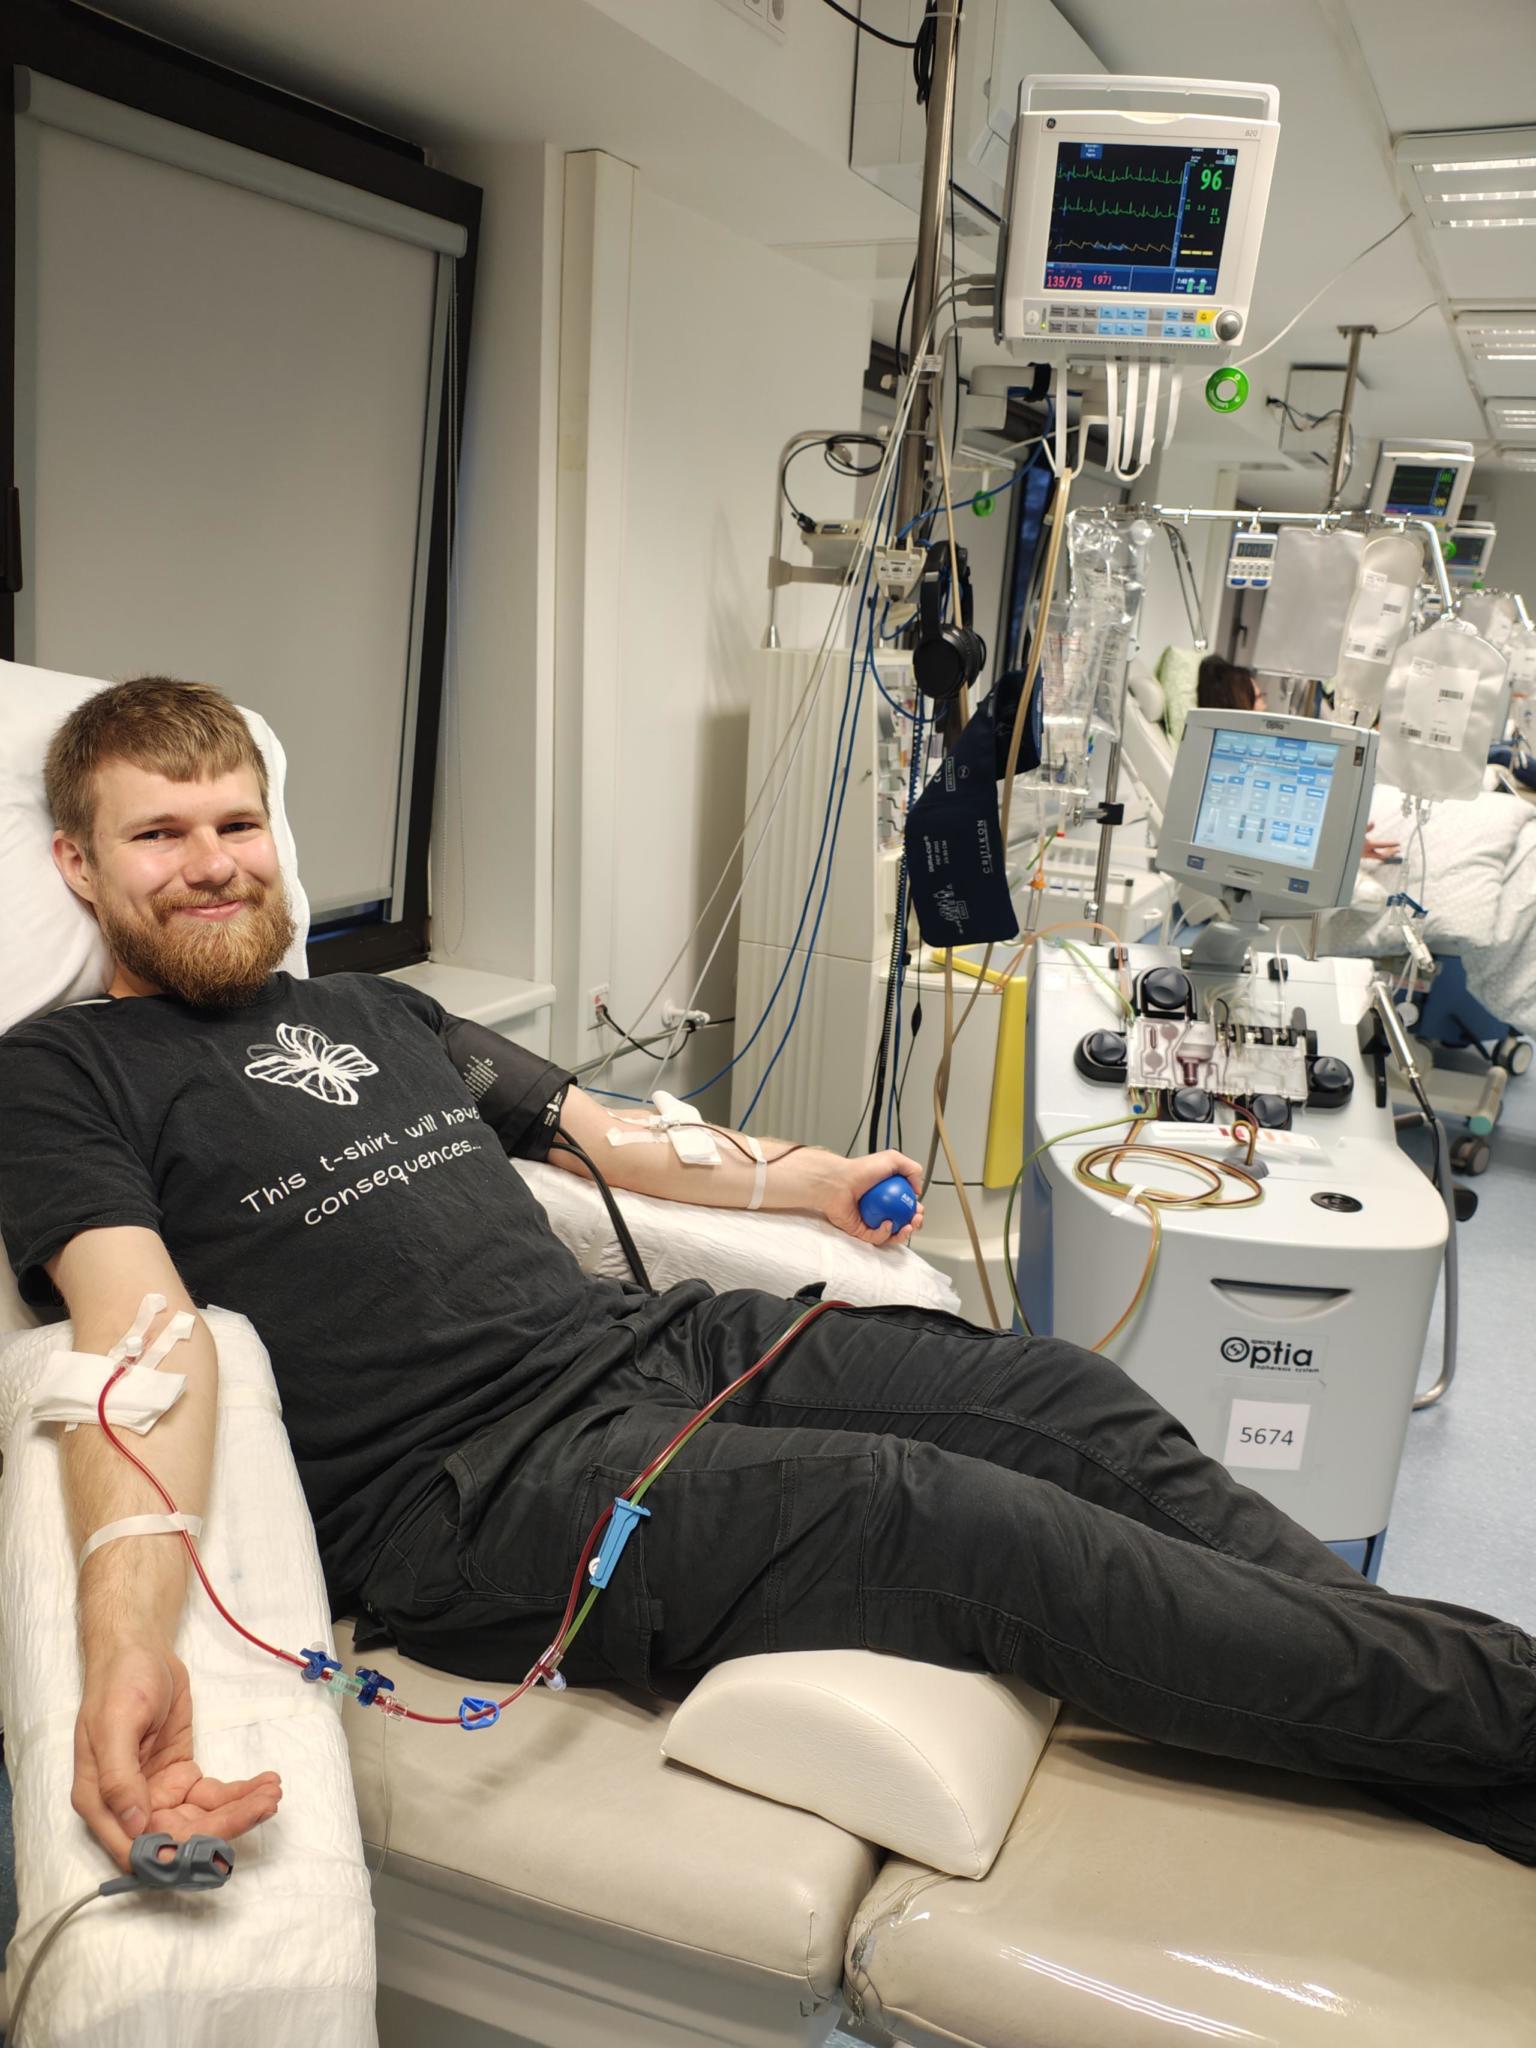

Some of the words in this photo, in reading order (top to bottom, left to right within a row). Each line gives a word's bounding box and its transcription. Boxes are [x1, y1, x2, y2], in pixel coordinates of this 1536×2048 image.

[1200, 169, 1222, 191] 96
[1047, 275, 1083, 289] 135/75
[1093, 274, 1112, 286] (97)
[240, 1173, 307, 1213] This
[320, 1132, 399, 1172] t-shirt
[404, 1113, 439, 1139] will
[1220, 1336, 1313, 1369] Optia
[1239, 1426, 1295, 1446] 5674
